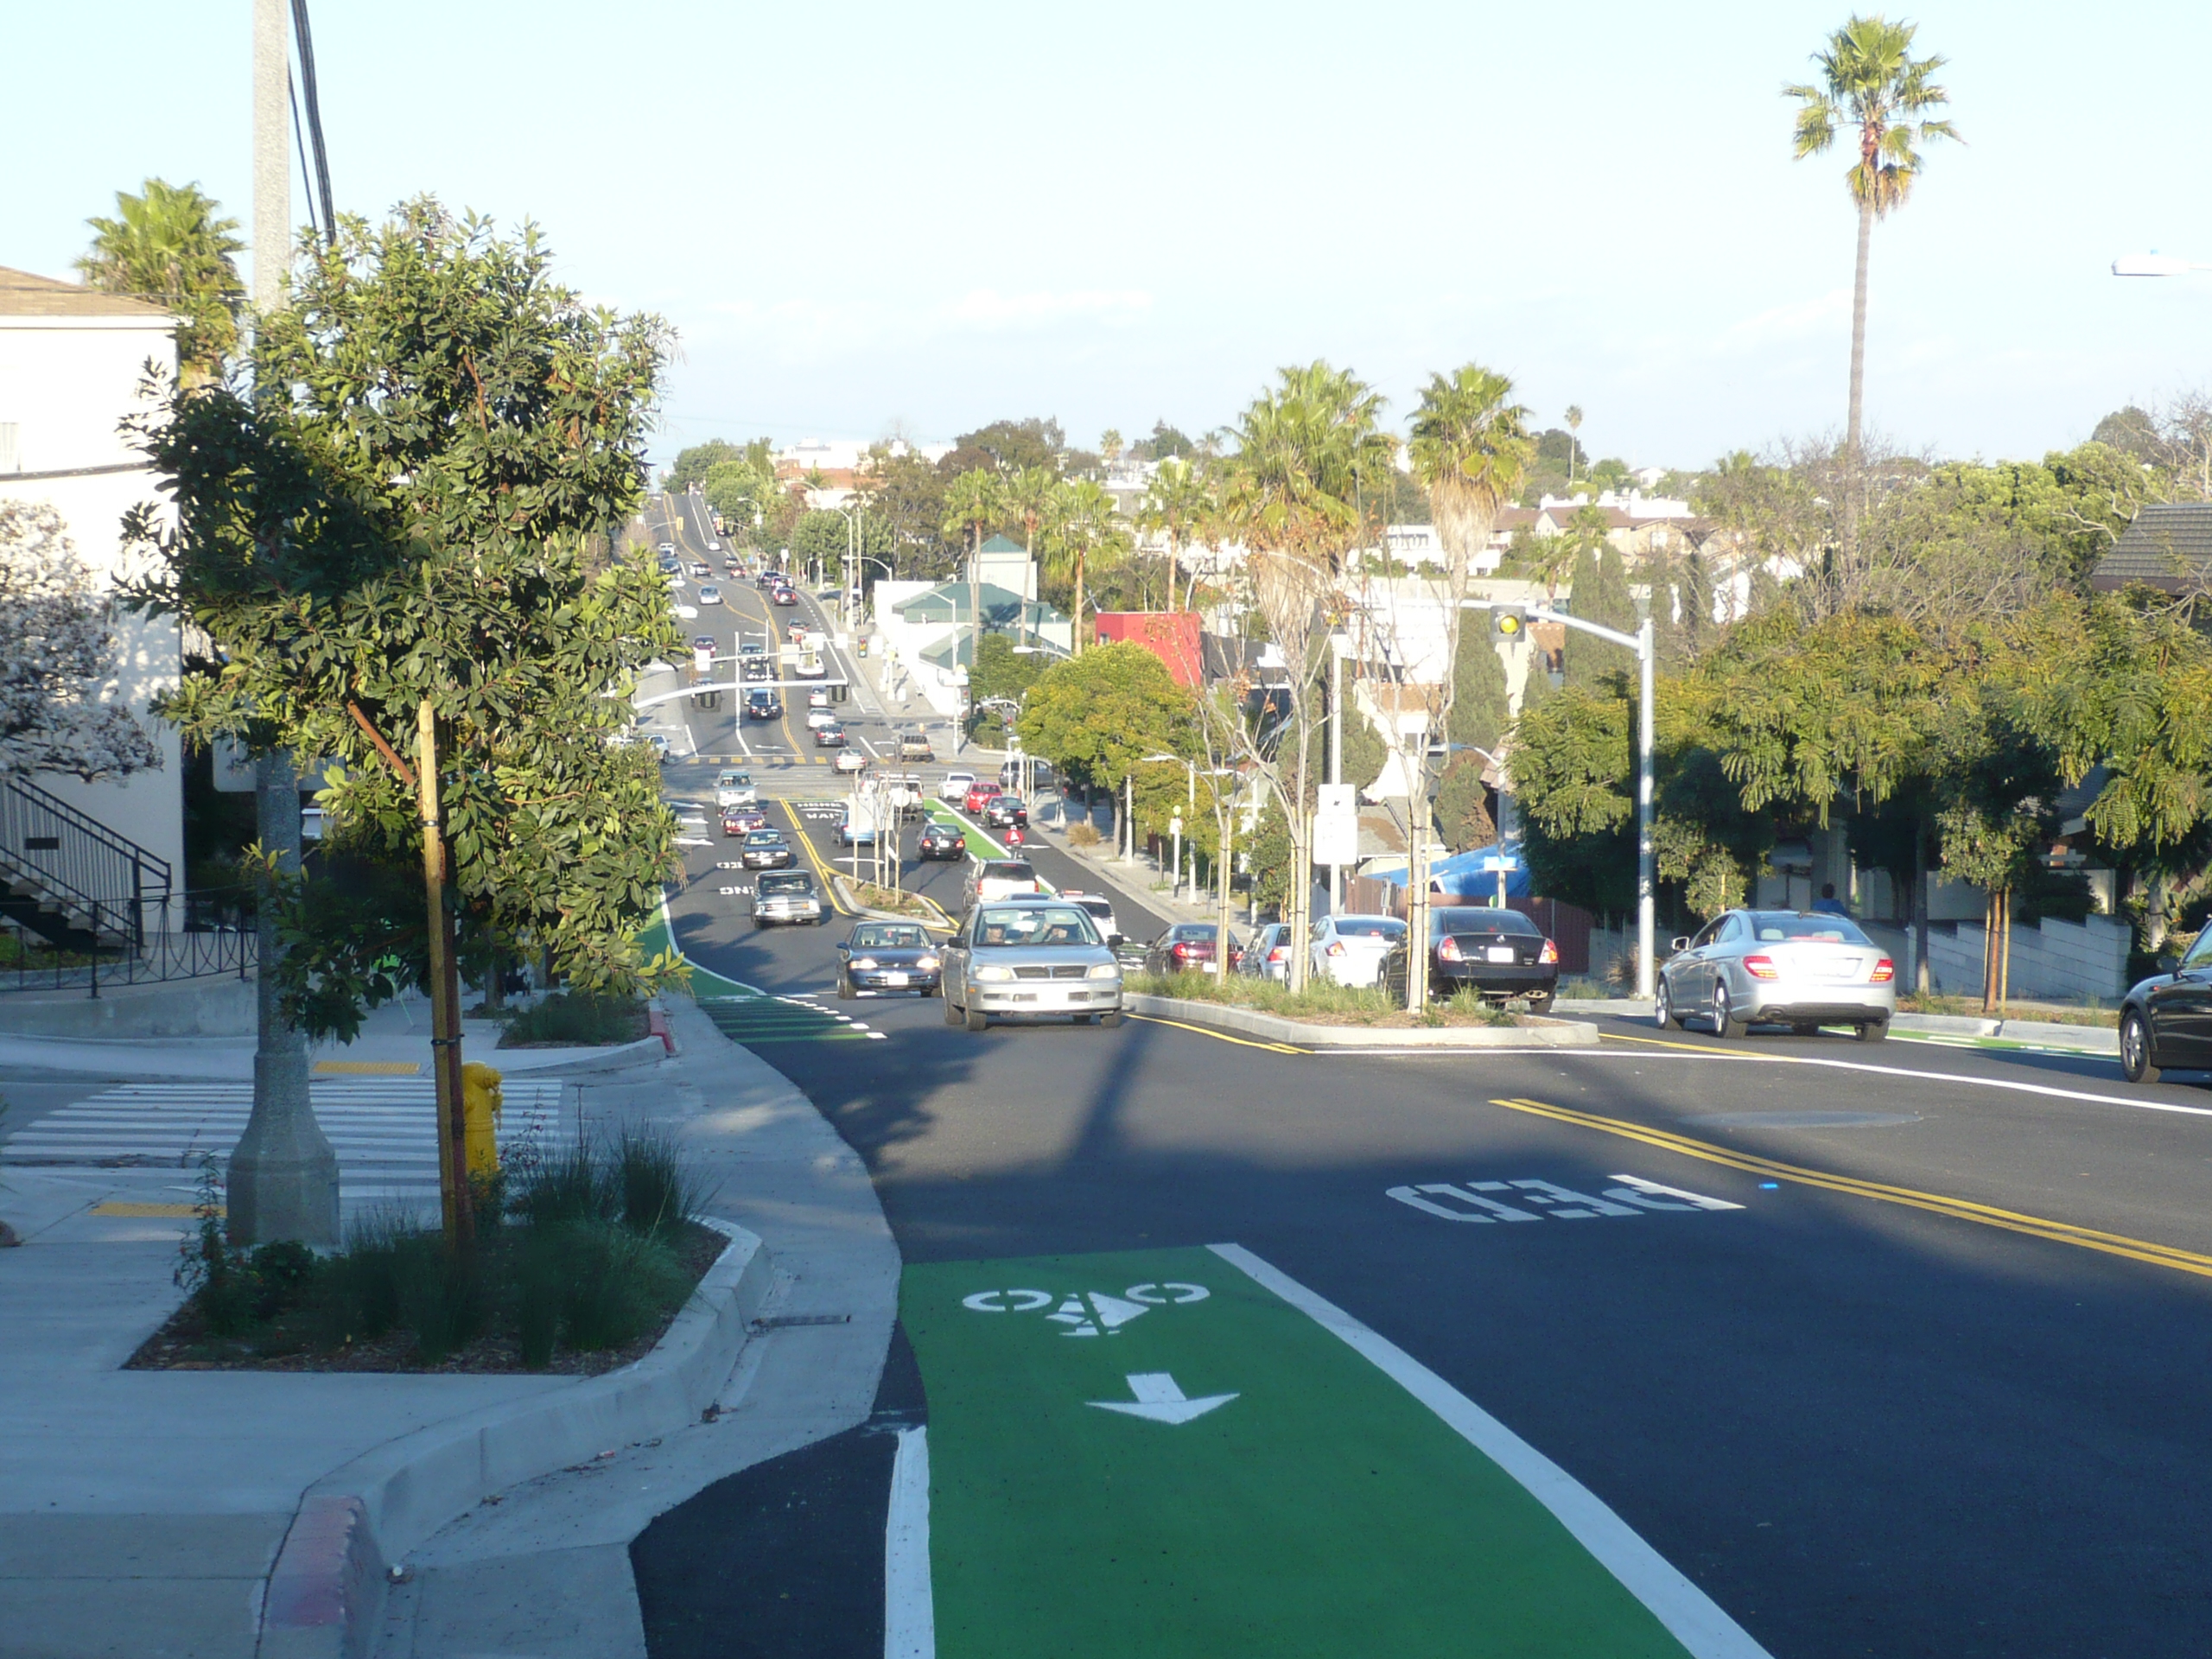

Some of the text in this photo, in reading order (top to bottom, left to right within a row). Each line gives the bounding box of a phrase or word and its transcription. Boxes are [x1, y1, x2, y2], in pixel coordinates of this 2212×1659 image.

[716, 861, 744, 869] ED
[719, 886, 754, 896] ING
[1385, 1173, 1747, 1223] PED
